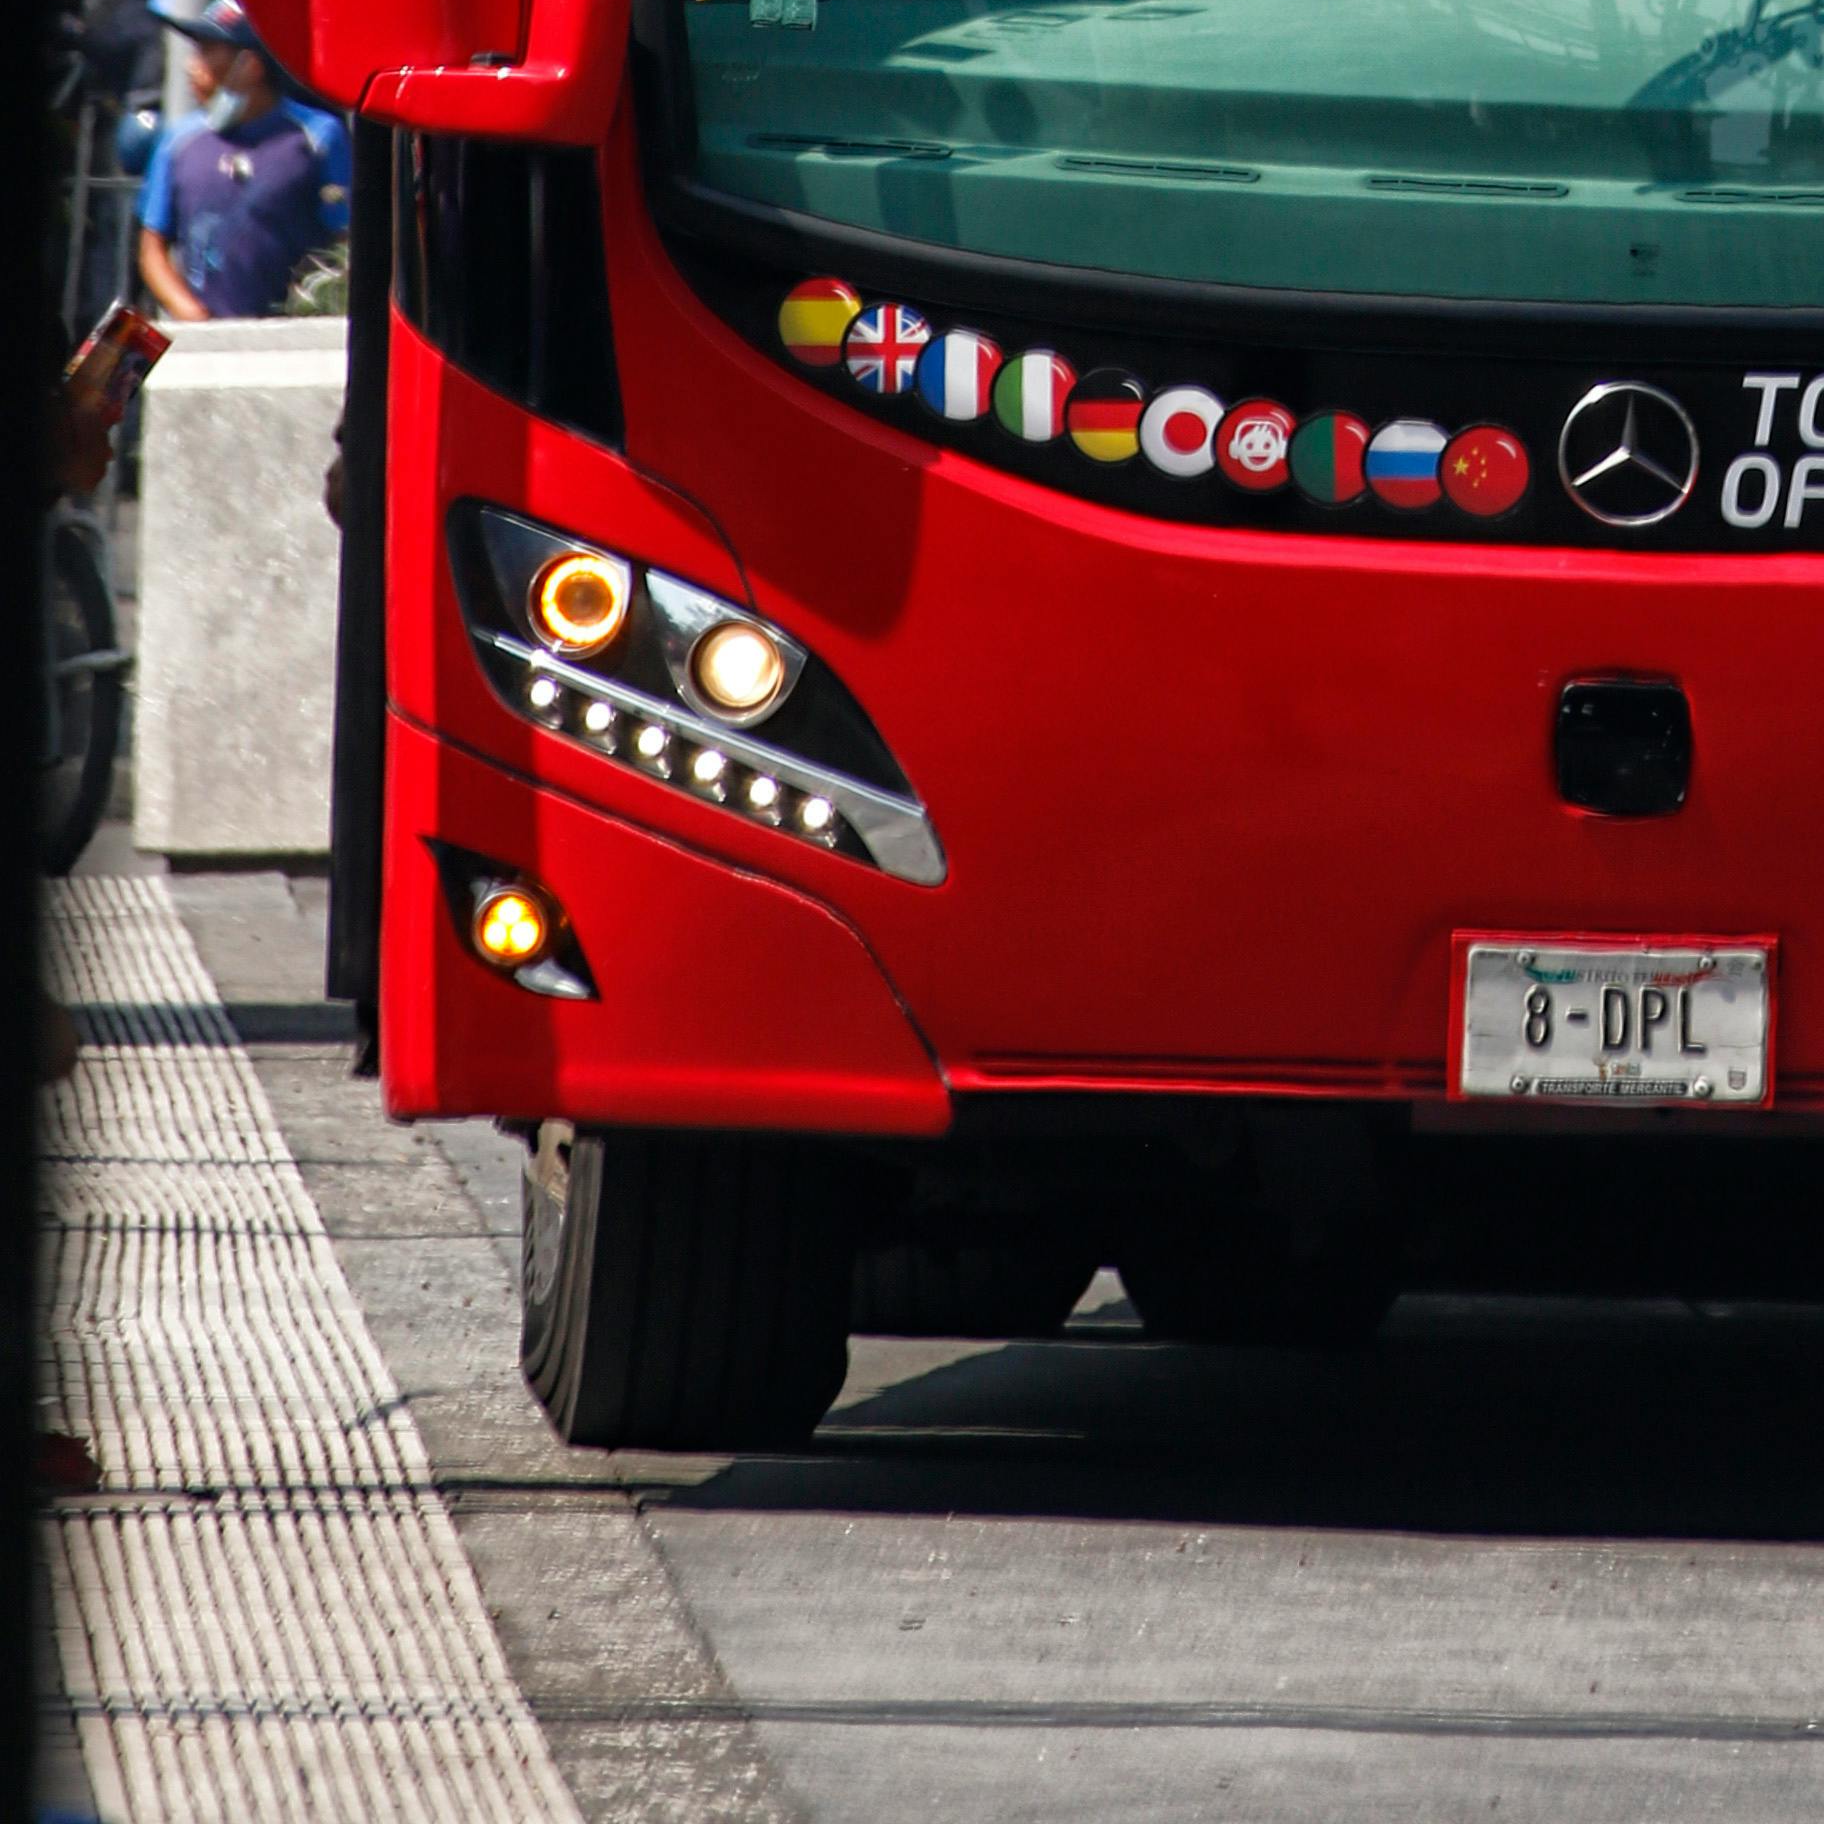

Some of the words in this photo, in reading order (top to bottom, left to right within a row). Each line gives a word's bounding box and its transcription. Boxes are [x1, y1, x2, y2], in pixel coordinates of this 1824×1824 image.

[1523, 983, 1706, 1054] 8-DPL
[1541, 1080, 1616, 1095] TRANSPORTE
[1619, 1081, 1684, 1095] MERCANTIL
